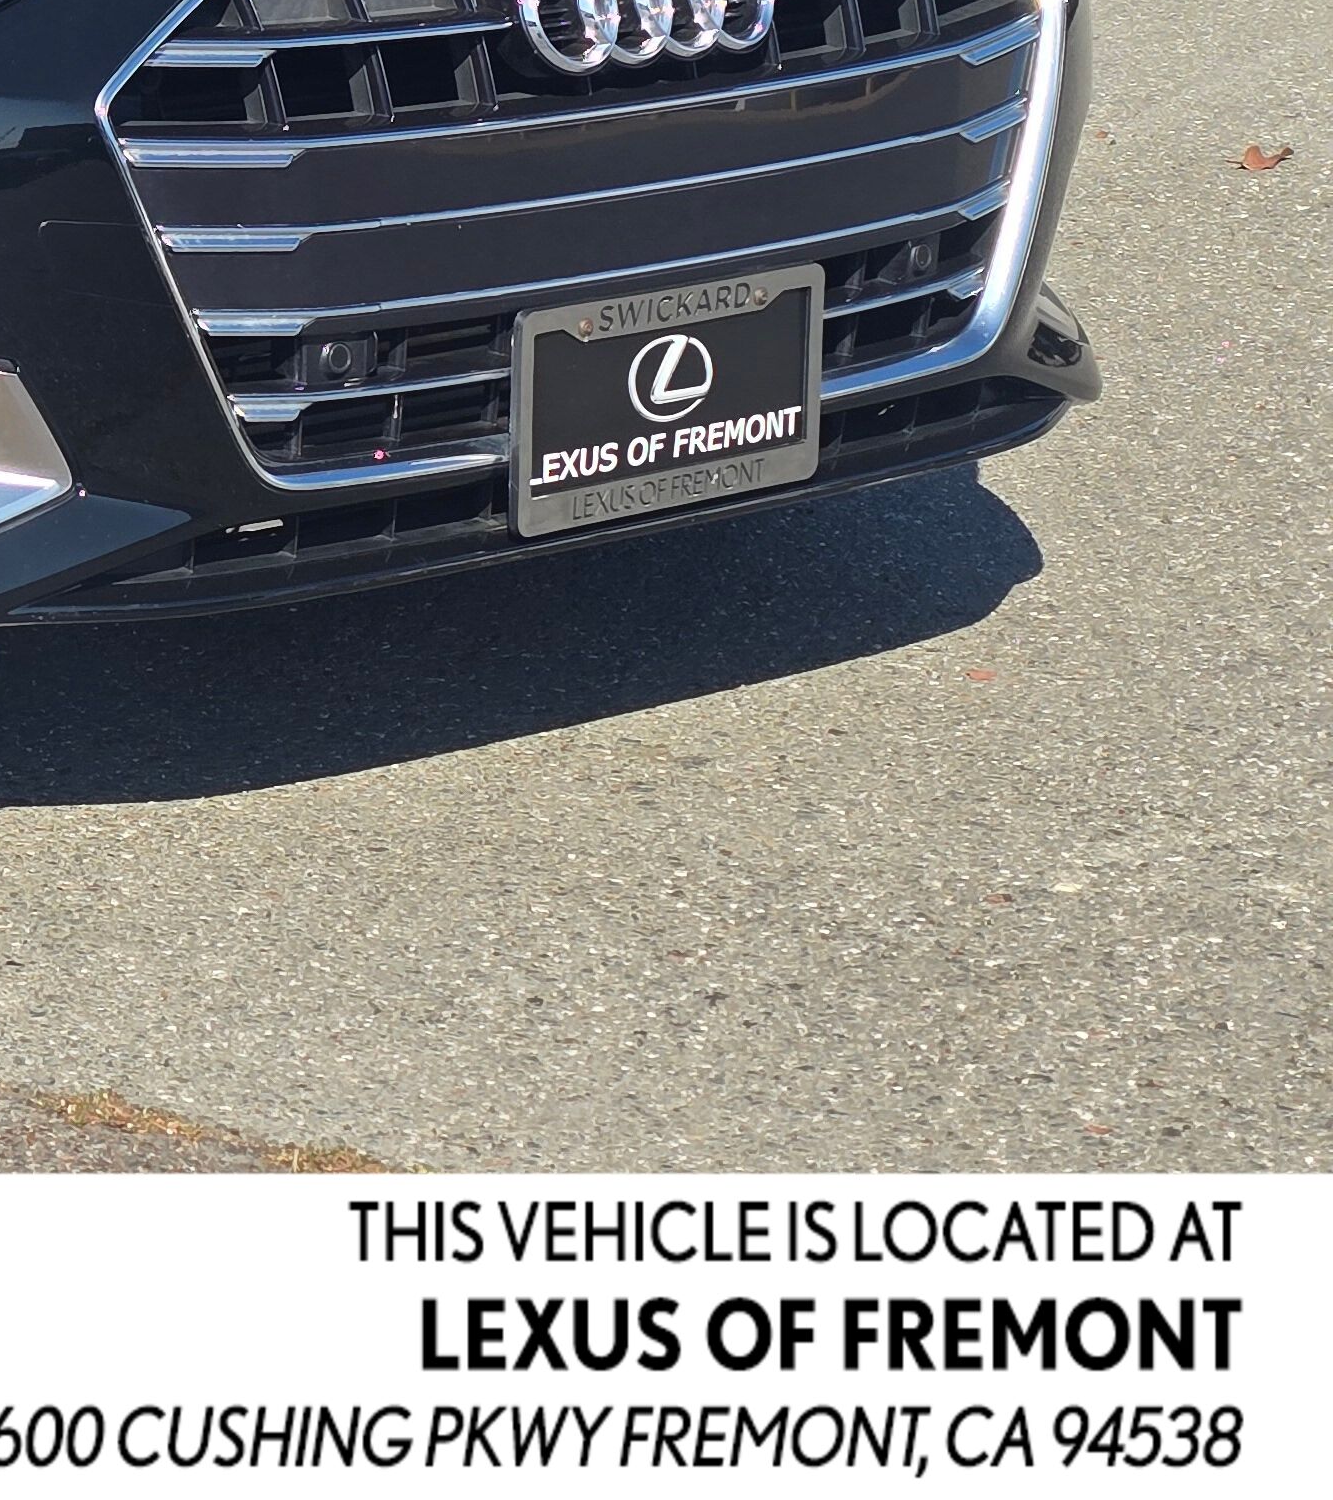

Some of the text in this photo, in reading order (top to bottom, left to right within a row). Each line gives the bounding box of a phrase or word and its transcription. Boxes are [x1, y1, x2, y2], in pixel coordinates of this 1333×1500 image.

[598, 282, 752, 332] SWICKARD
[627, 432, 665, 465] OF
[673, 406, 802, 459] FREMONT
[572, 458, 766, 521] LEXUS OF FREMONT
